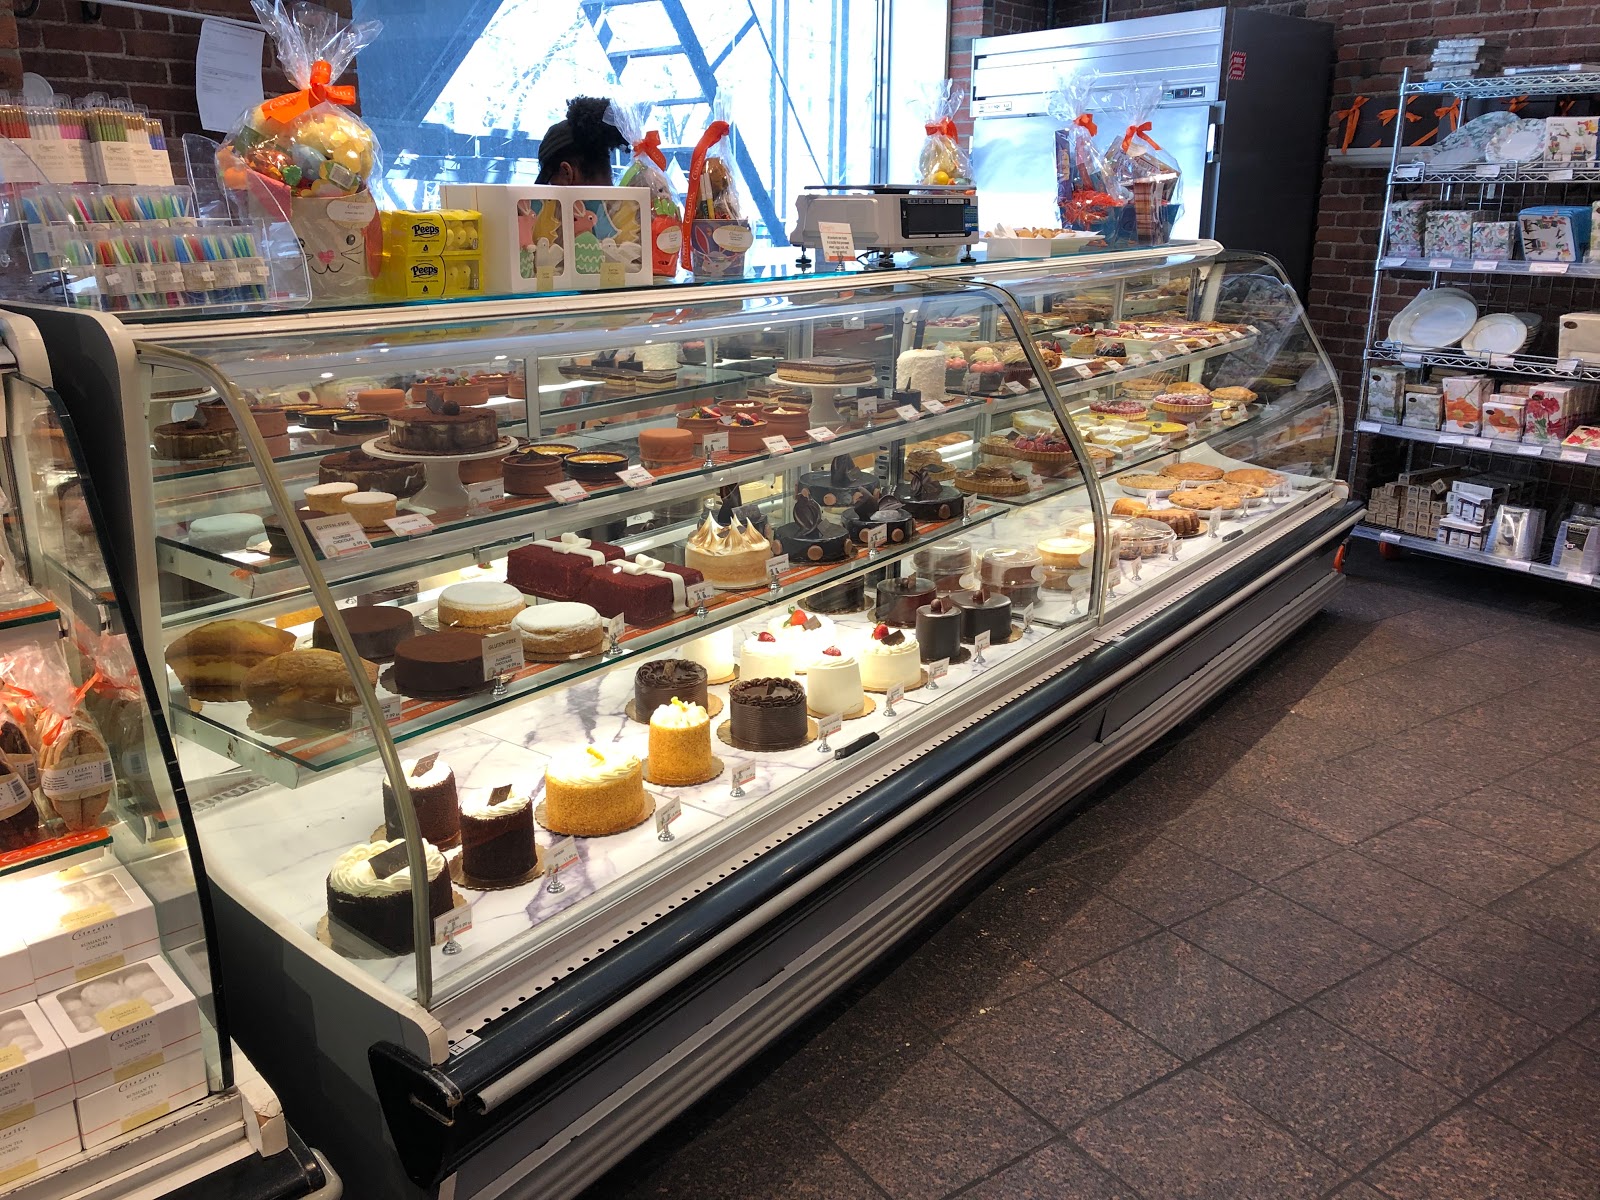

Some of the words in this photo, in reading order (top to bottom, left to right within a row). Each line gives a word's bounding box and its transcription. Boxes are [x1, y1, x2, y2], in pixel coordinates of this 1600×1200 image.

[411, 224, 440, 237] Peeps
[410, 265, 439, 278] Peeps
[315, 520, 351, 531] GLUTEN-FREE
[333, 537, 355, 545] CHOCOLATE
[487, 638, 516, 650] GLUTEN-FREE
[80, 937, 102, 948] RUSSIAN
[86, 941, 109, 951] COOKIES
[119, 1036, 141, 1048] RUSSIAN
[141, 1032, 151, 1040] TEA
[124, 1039, 147, 1051] COOKIES
[126, 1087, 148, 1099] RUSSIAN
[131, 1090, 154, 1102] COOKIES
